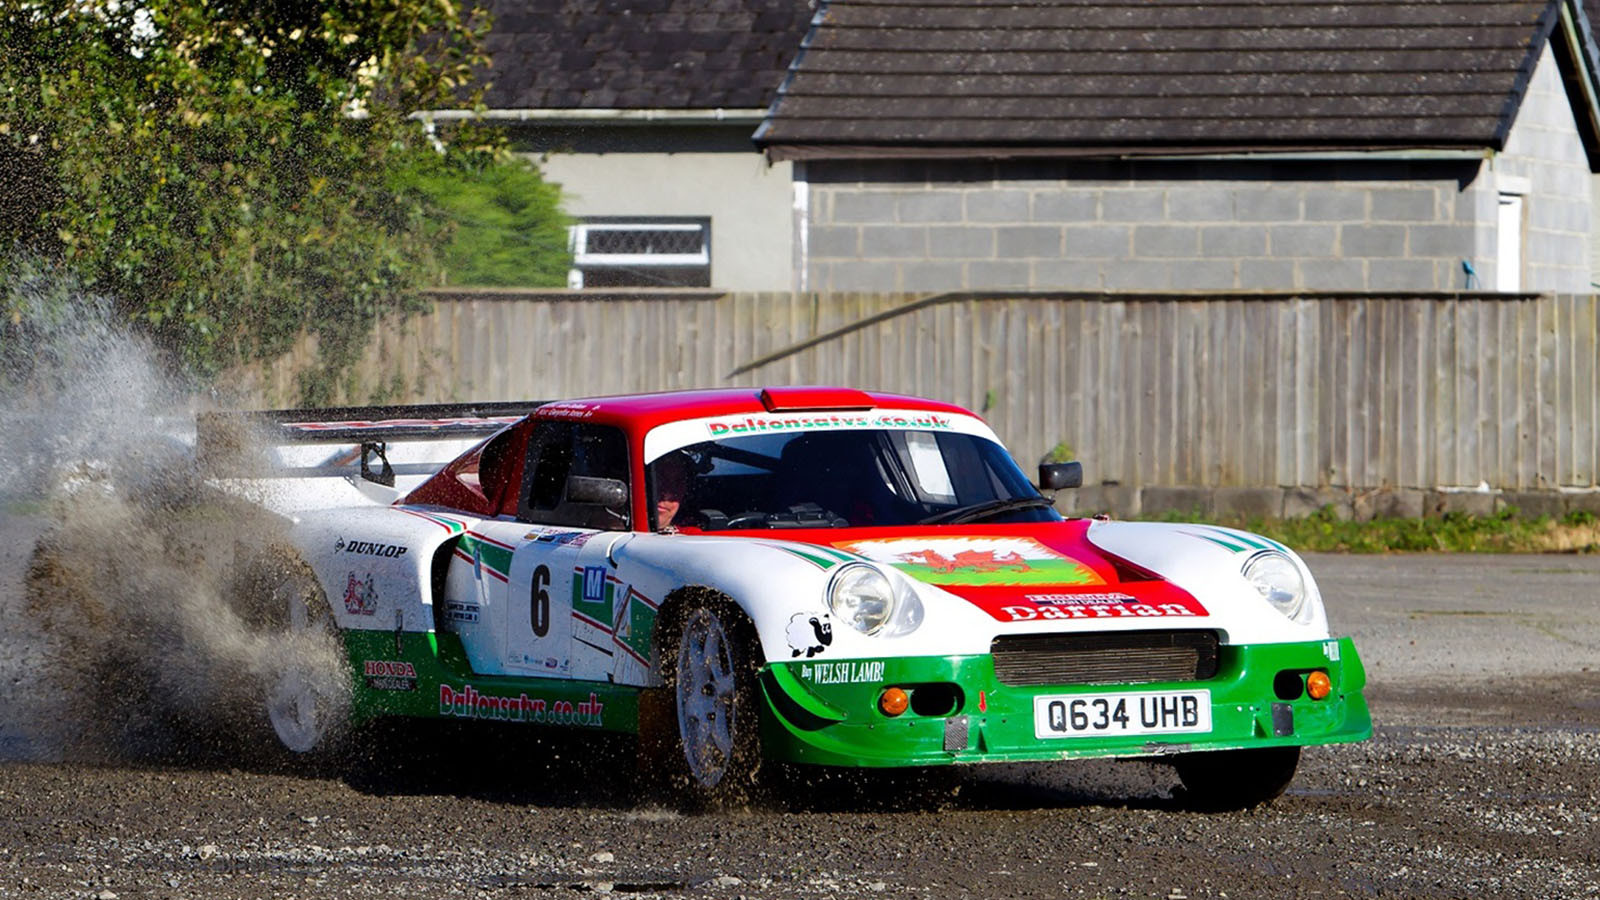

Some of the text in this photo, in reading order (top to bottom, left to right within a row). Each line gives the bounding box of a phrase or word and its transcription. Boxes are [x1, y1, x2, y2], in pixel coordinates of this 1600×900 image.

[706, 412, 951, 436] Daltonsatvs.co.uk
[346, 541, 408, 558] DUNLOP
[586, 569, 601, 598] M
[531, 564, 551, 638] 6
[1001, 603, 1196, 620] Darrian
[364, 660, 417, 678] HONDA
[814, 663, 850, 684] WELSH
[850, 661, 885, 683] LAMB!
[439, 684, 604, 727] Daltonsatvs.co.uk
[1048, 695, 1199, 732] Q634 UHB
